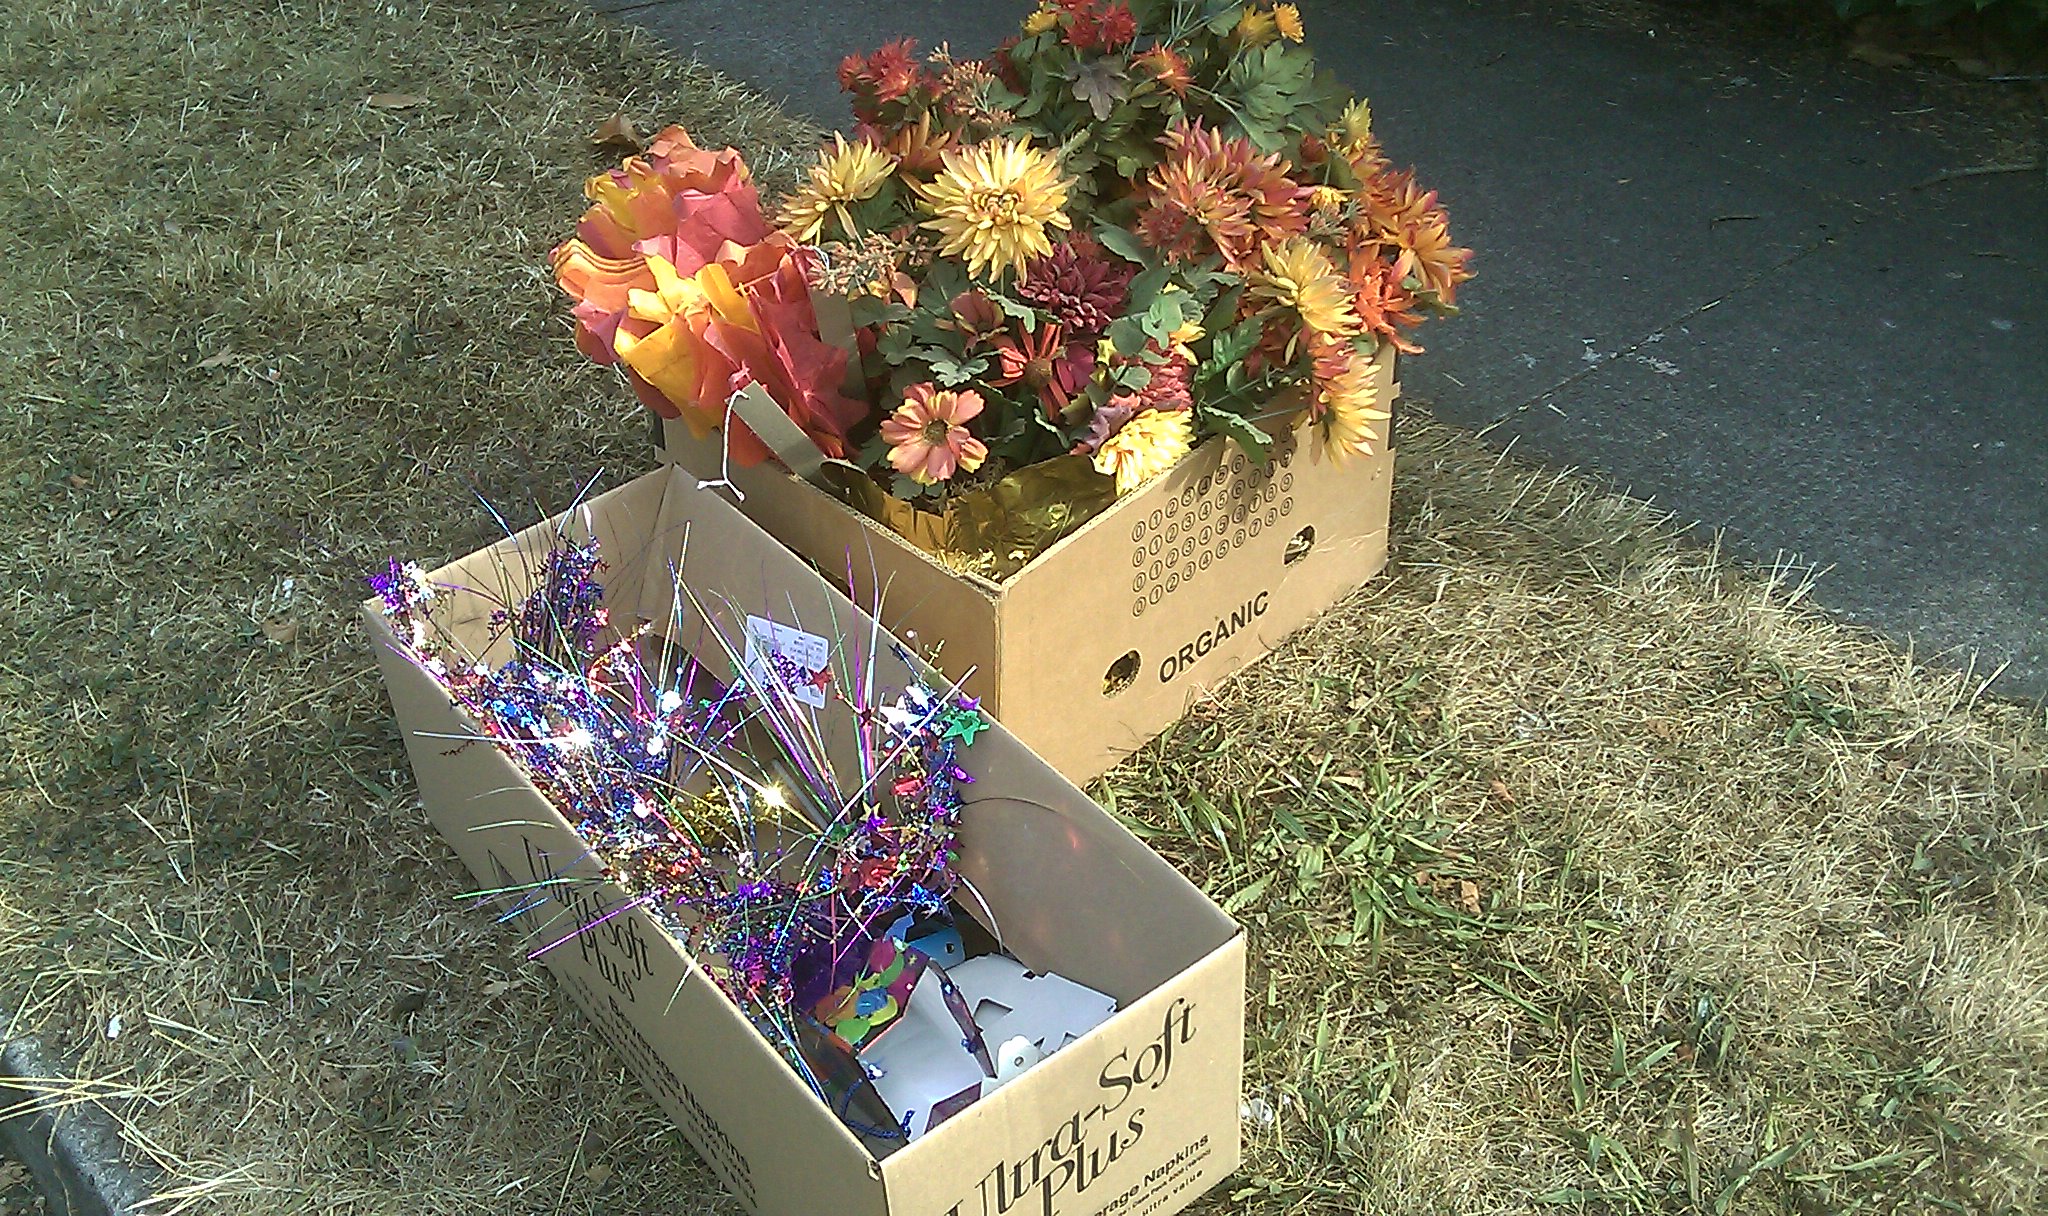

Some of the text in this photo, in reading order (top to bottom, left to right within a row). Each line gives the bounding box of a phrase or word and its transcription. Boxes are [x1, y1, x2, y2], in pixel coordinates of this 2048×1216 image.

[1158, 590, 1269, 684] ORGANIC
[1035, 1107, 1144, 1216] Plus
[1143, 1134, 1209, 1187] Napkins
